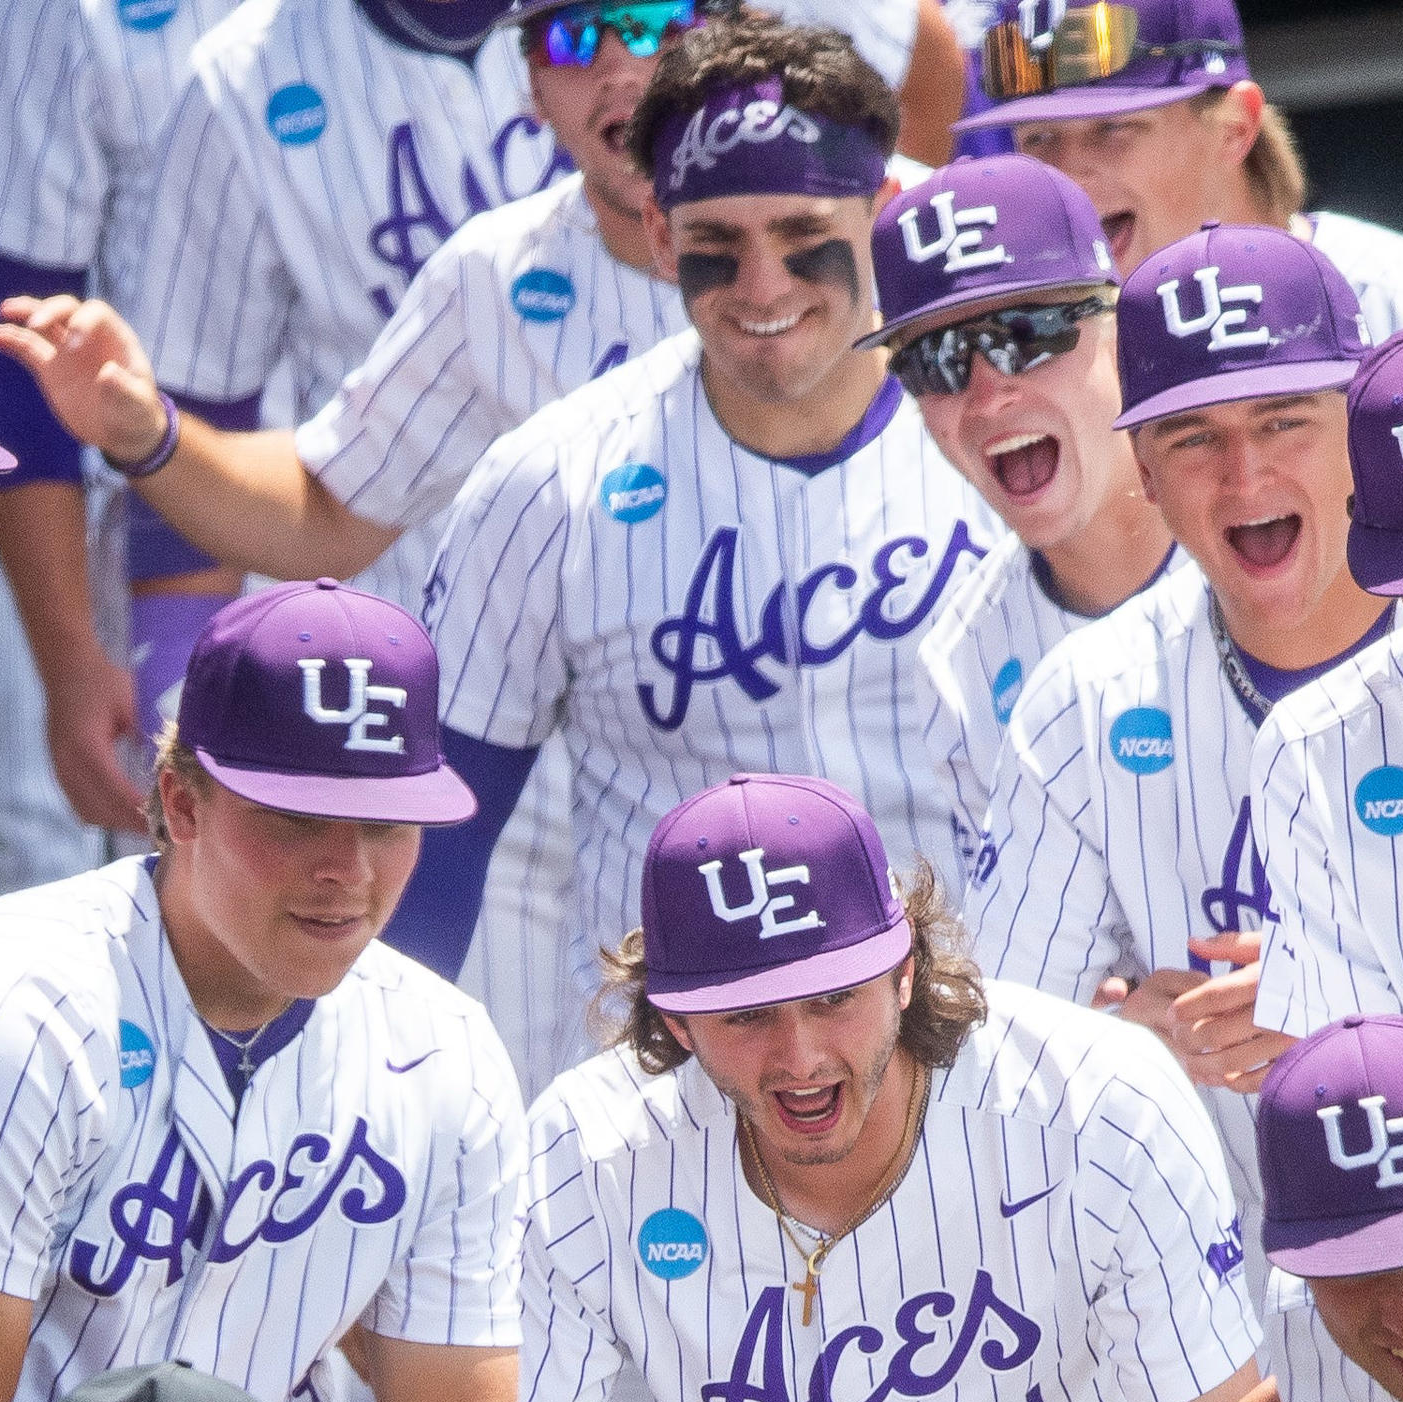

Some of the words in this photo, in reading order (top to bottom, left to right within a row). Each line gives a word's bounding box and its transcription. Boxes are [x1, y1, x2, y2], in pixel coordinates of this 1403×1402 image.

[899, 191, 1005, 271] UE
[1157, 267, 1269, 352] UE
[299, 658, 404, 753] UE
[698, 847, 819, 940] UE
[647, 1242, 702, 1262] NCAA
